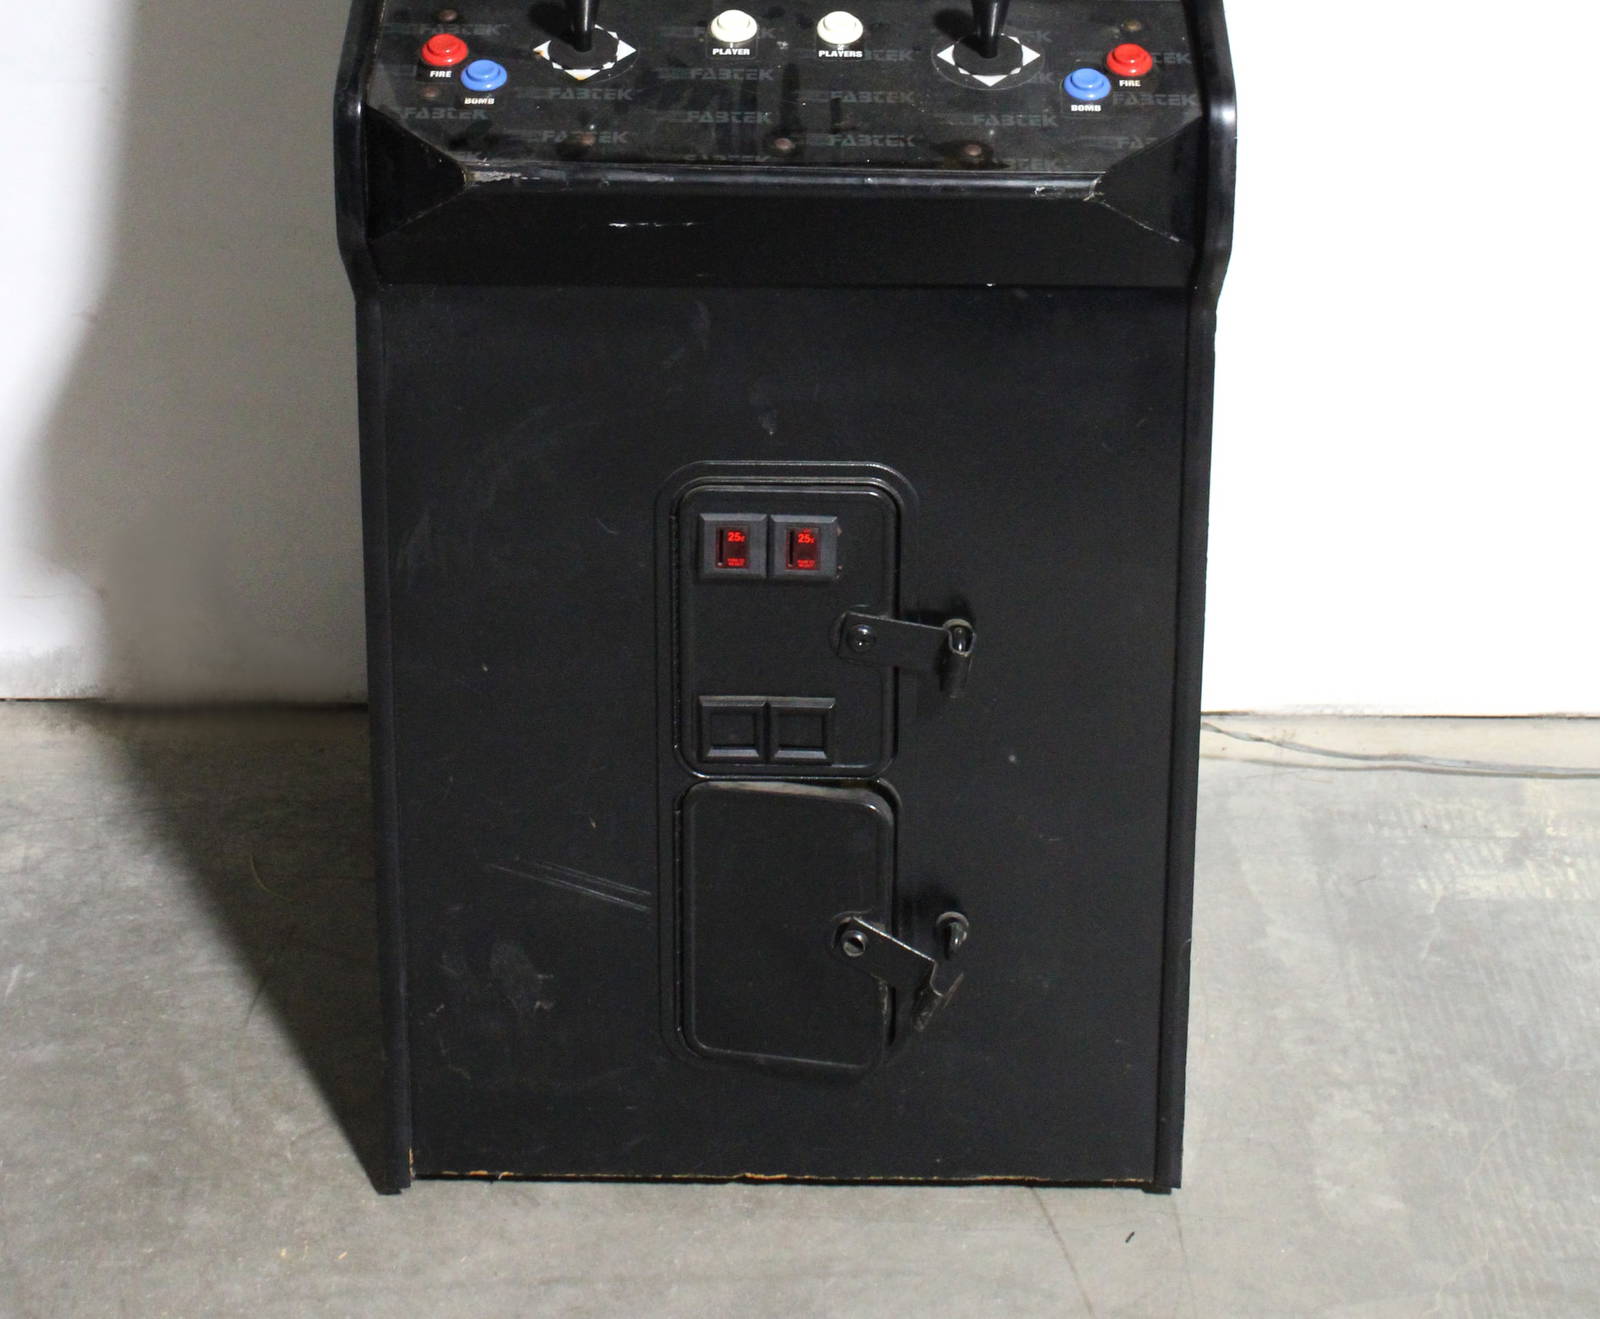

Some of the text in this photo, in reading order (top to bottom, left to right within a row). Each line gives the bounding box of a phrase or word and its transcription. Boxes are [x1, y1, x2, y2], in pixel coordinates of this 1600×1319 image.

[712, 48, 751, 56] PLAYER
[818, 50, 863, 58] PLAYERS
[429, 70, 452, 78] FIRE
[1119, 79, 1142, 87] FIRE
[464, 97, 495, 105] BOMB
[1070, 104, 1102, 112] BOMB
